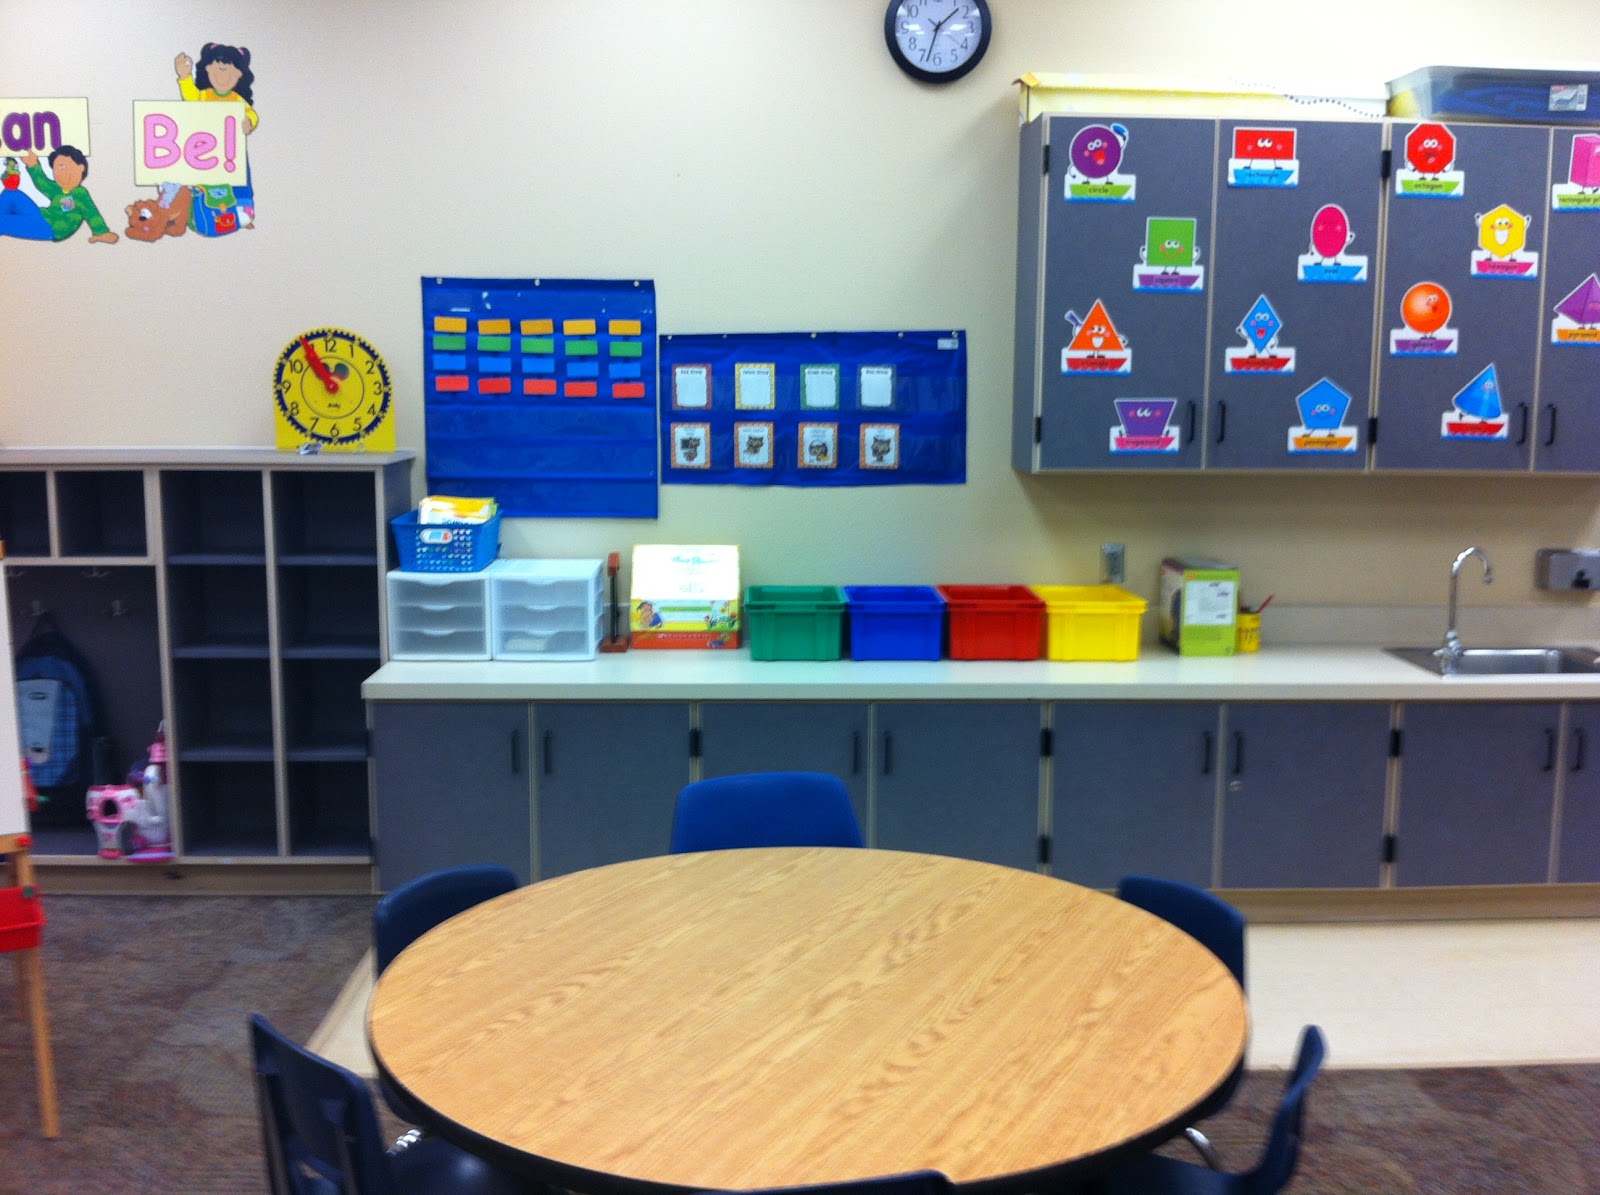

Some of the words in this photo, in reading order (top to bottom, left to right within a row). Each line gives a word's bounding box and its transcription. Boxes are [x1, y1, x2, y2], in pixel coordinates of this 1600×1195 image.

[906, 5, 919, 18] 10
[962, 6, 969, 19] 2
[908, 37, 917, 50] 8
[960, 37, 968, 50] 4
[918, 48, 926, 62] 7
[932, 52, 942, 66] 6
[950, 48, 958, 62] 5
[0, 111, 62, 151] an
[143, 113, 236, 173] Be!
[323, 337, 337, 353] 12
[349, 344, 354, 358] 1
[289, 360, 304, 374] 10
[365, 361, 375, 375] 2
[281, 380, 292, 394] 9
[373, 382, 382, 396] 3
[290, 401, 299, 416] 8
[367, 403, 376, 416] 4
[309, 417, 319, 431] 7
[330, 423, 340, 437] 6
[353, 418, 362, 431] 5
